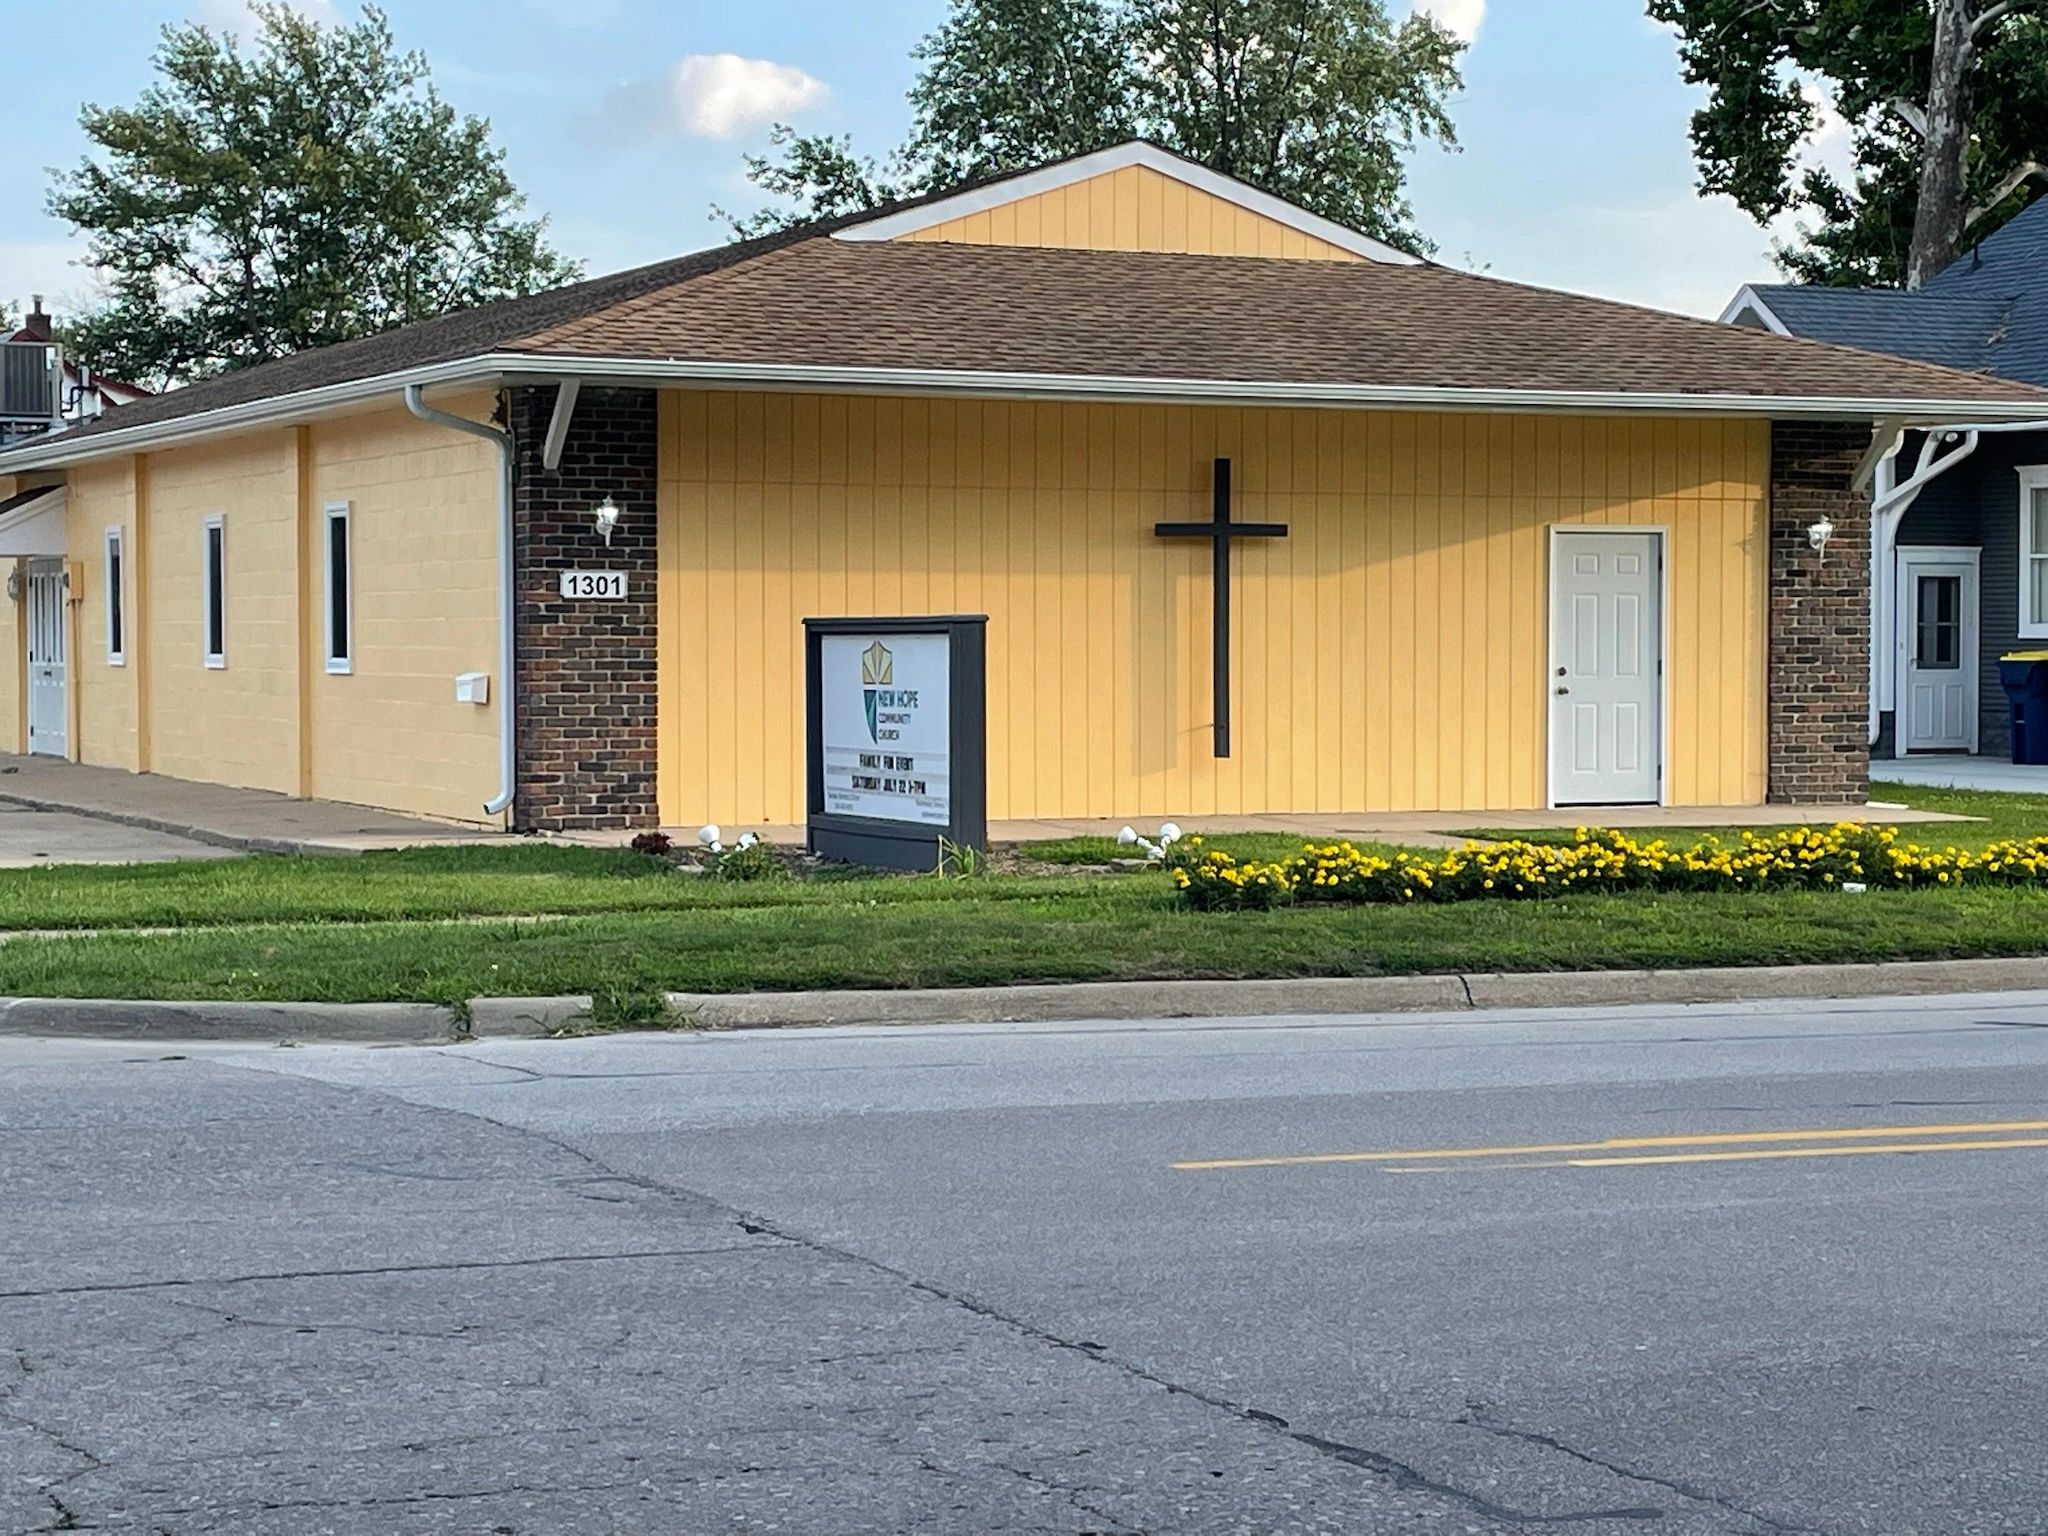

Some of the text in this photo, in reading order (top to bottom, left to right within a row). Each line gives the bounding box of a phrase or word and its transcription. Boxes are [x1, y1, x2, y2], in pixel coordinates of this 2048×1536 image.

[568, 575, 620, 596] 1301
[878, 690, 919, 709] NEW HOPE
[859, 753, 914, 771] FAMILY FUN EVENT
[852, 775, 881, 790] SATURDAY
[883, 778, 897, 793] JULY
